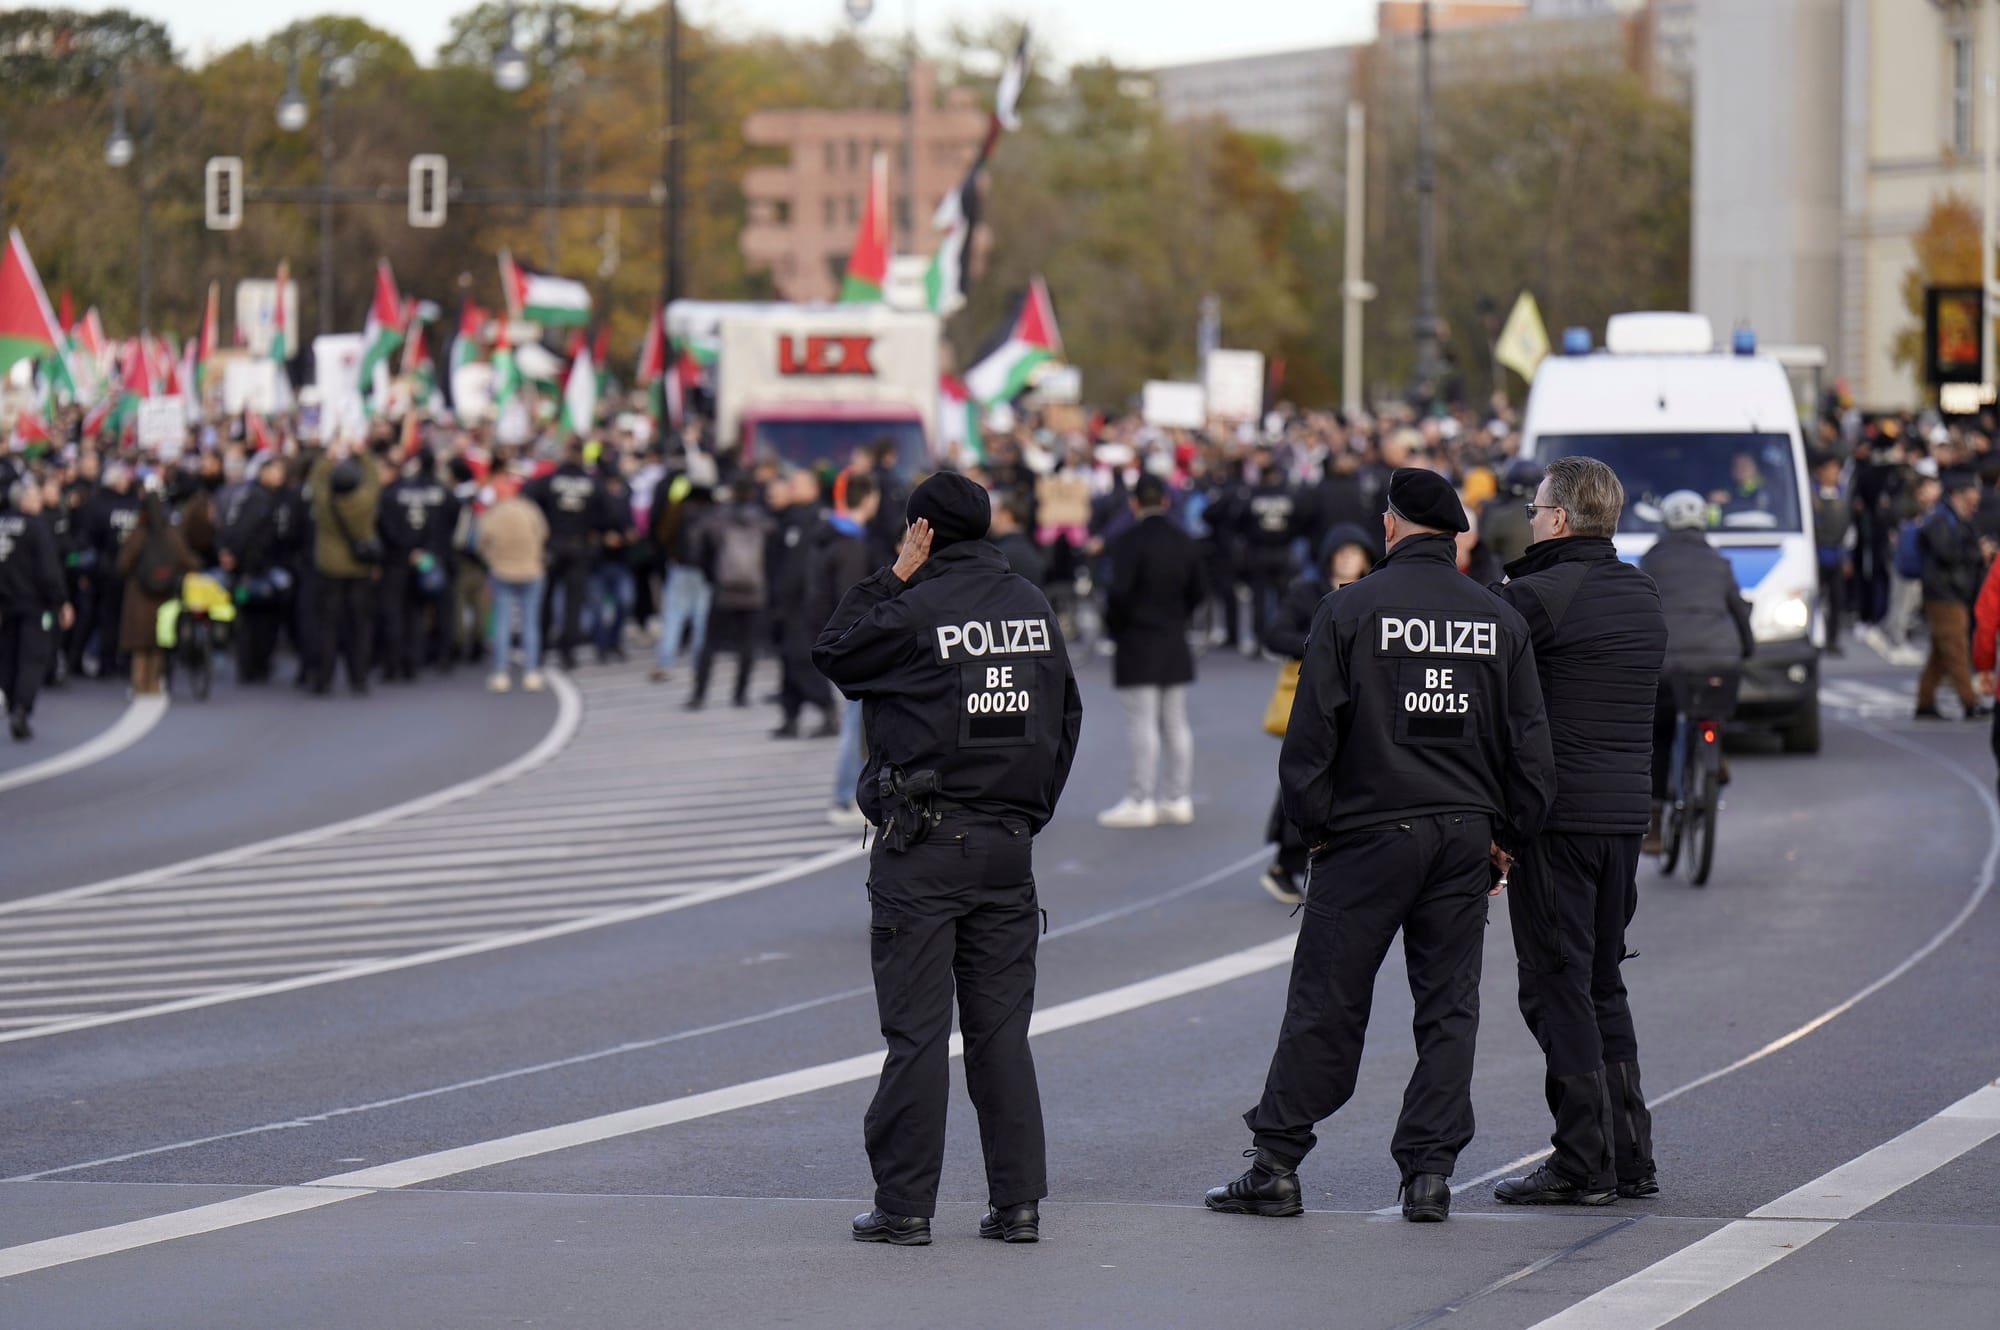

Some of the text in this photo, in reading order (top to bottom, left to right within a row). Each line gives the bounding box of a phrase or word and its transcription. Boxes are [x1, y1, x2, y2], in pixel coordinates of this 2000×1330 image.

[778, 334, 875, 376] LEX
[936, 619, 1051, 659] POLIZEI
[1381, 617, 1497, 655] POLIZEI
[985, 666, 1014, 689] BE
[1425, 668, 1454, 689] BE
[967, 690, 1030, 714] 00020
[1404, 691, 1470, 713] 00015
